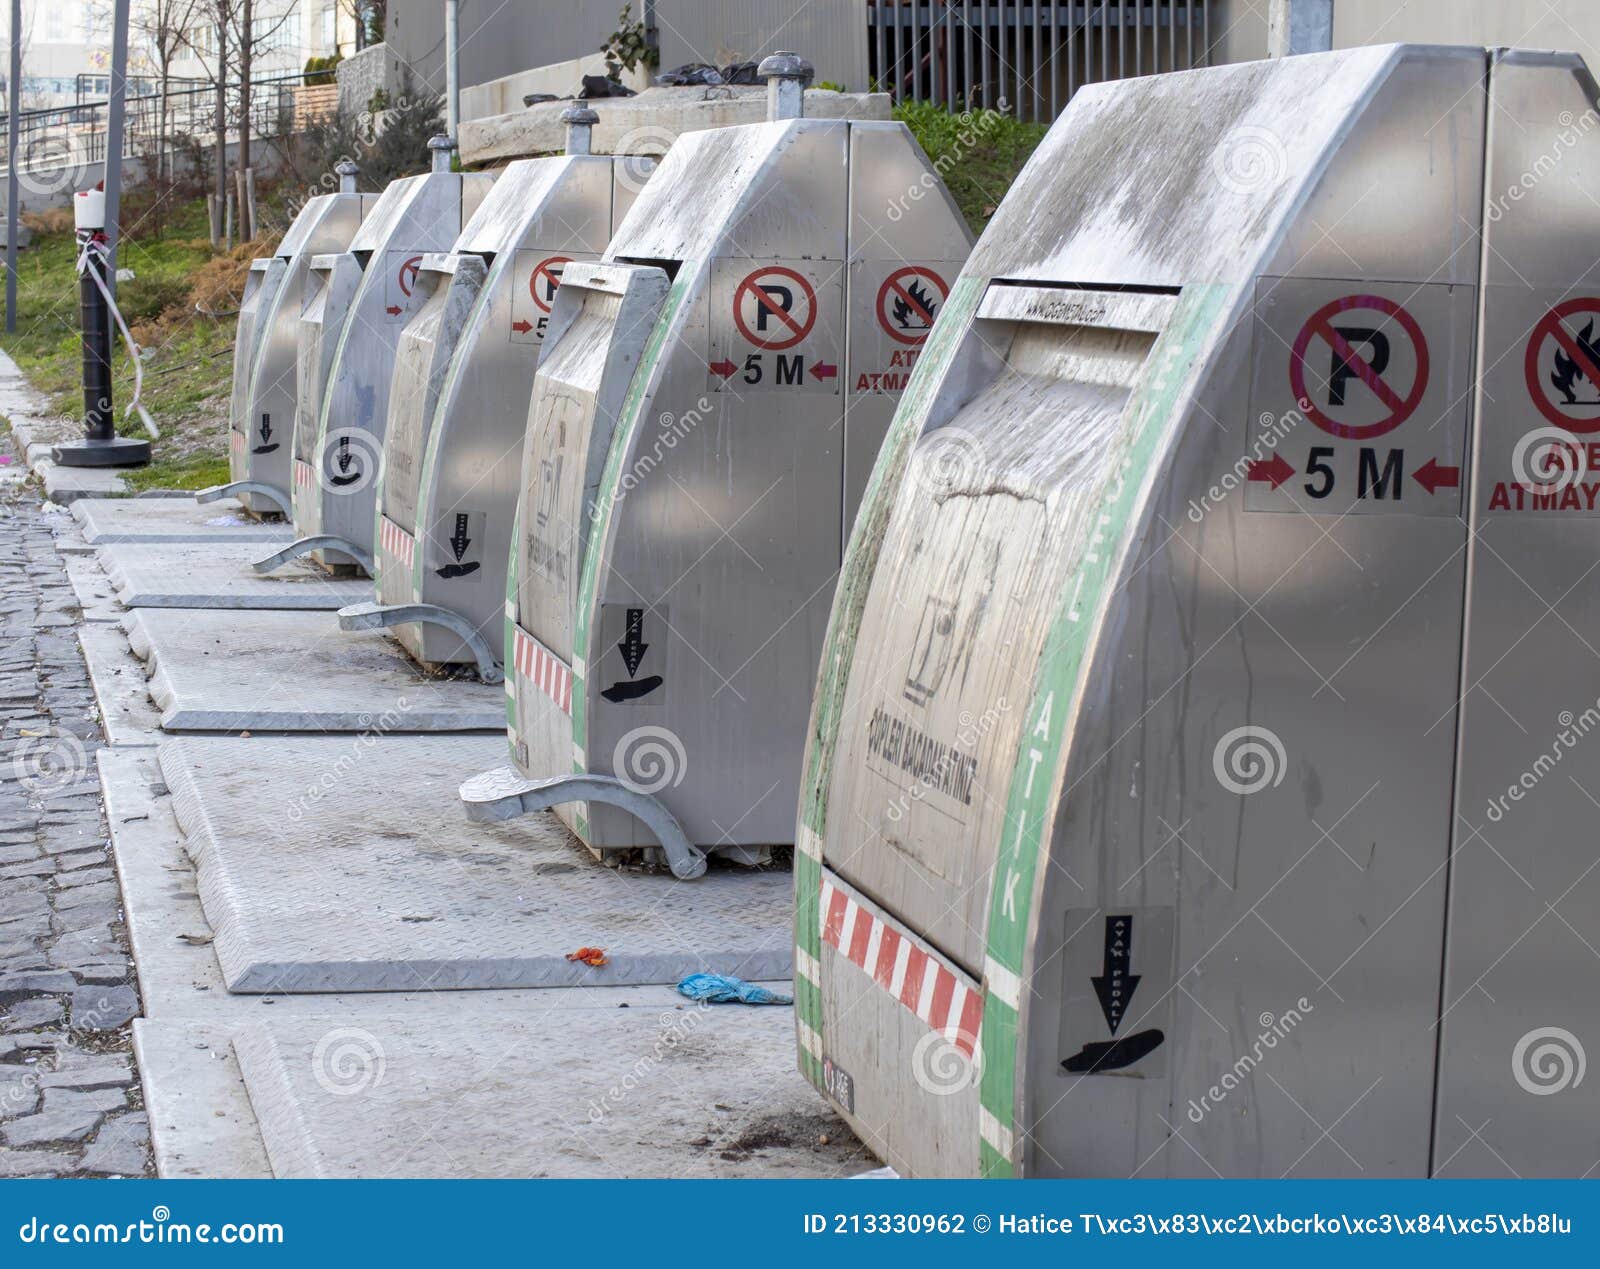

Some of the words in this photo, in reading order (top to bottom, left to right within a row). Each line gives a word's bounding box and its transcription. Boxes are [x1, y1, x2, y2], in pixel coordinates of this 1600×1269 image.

[743, 354, 762, 385] 5
[776, 355, 804, 385] M
[889, 350, 921, 368] AT
[1303, 447, 1335, 500] 5
[1357, 447, 1404, 500] M
[1002, 690, 1054, 923] ATIK
[1110, 920, 1125, 958] AYAK
[1111, 969, 1123, 1028] PEDALI
